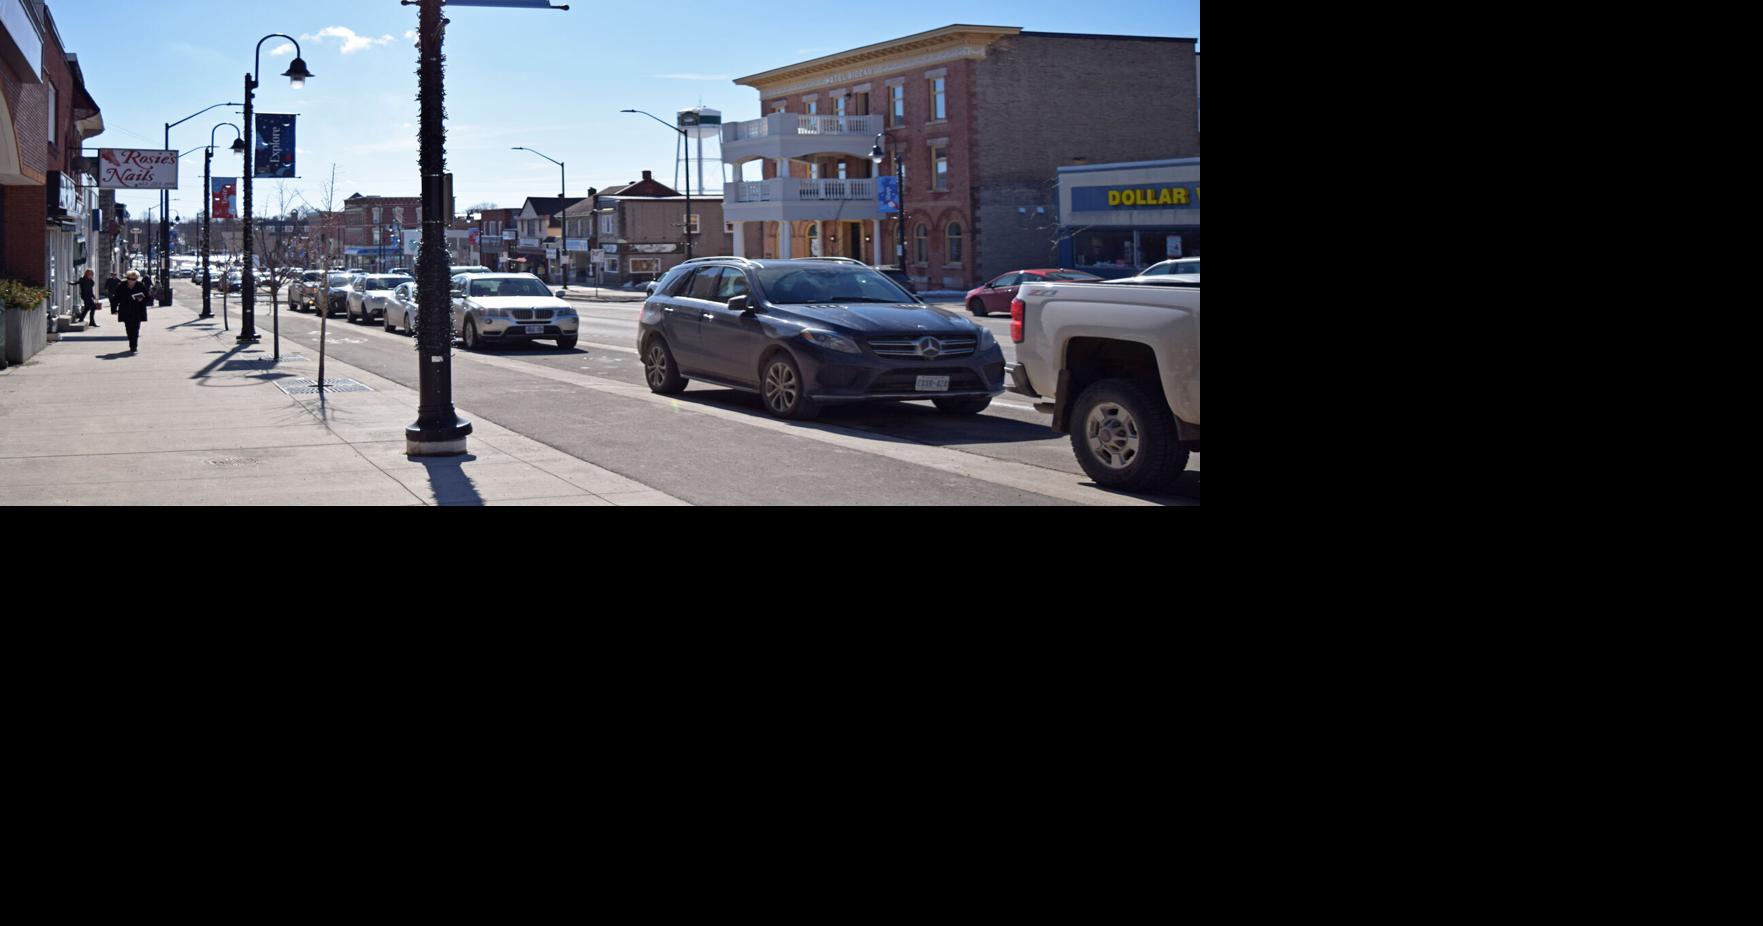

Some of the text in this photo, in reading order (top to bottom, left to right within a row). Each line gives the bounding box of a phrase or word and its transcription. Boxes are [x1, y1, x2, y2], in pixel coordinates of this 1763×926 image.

[268, 126, 282, 163] Explore
[121, 150, 176, 169] Rosie's
[103, 167, 155, 187] Nails
[1108, 187, 1187, 206] DOLLAR
